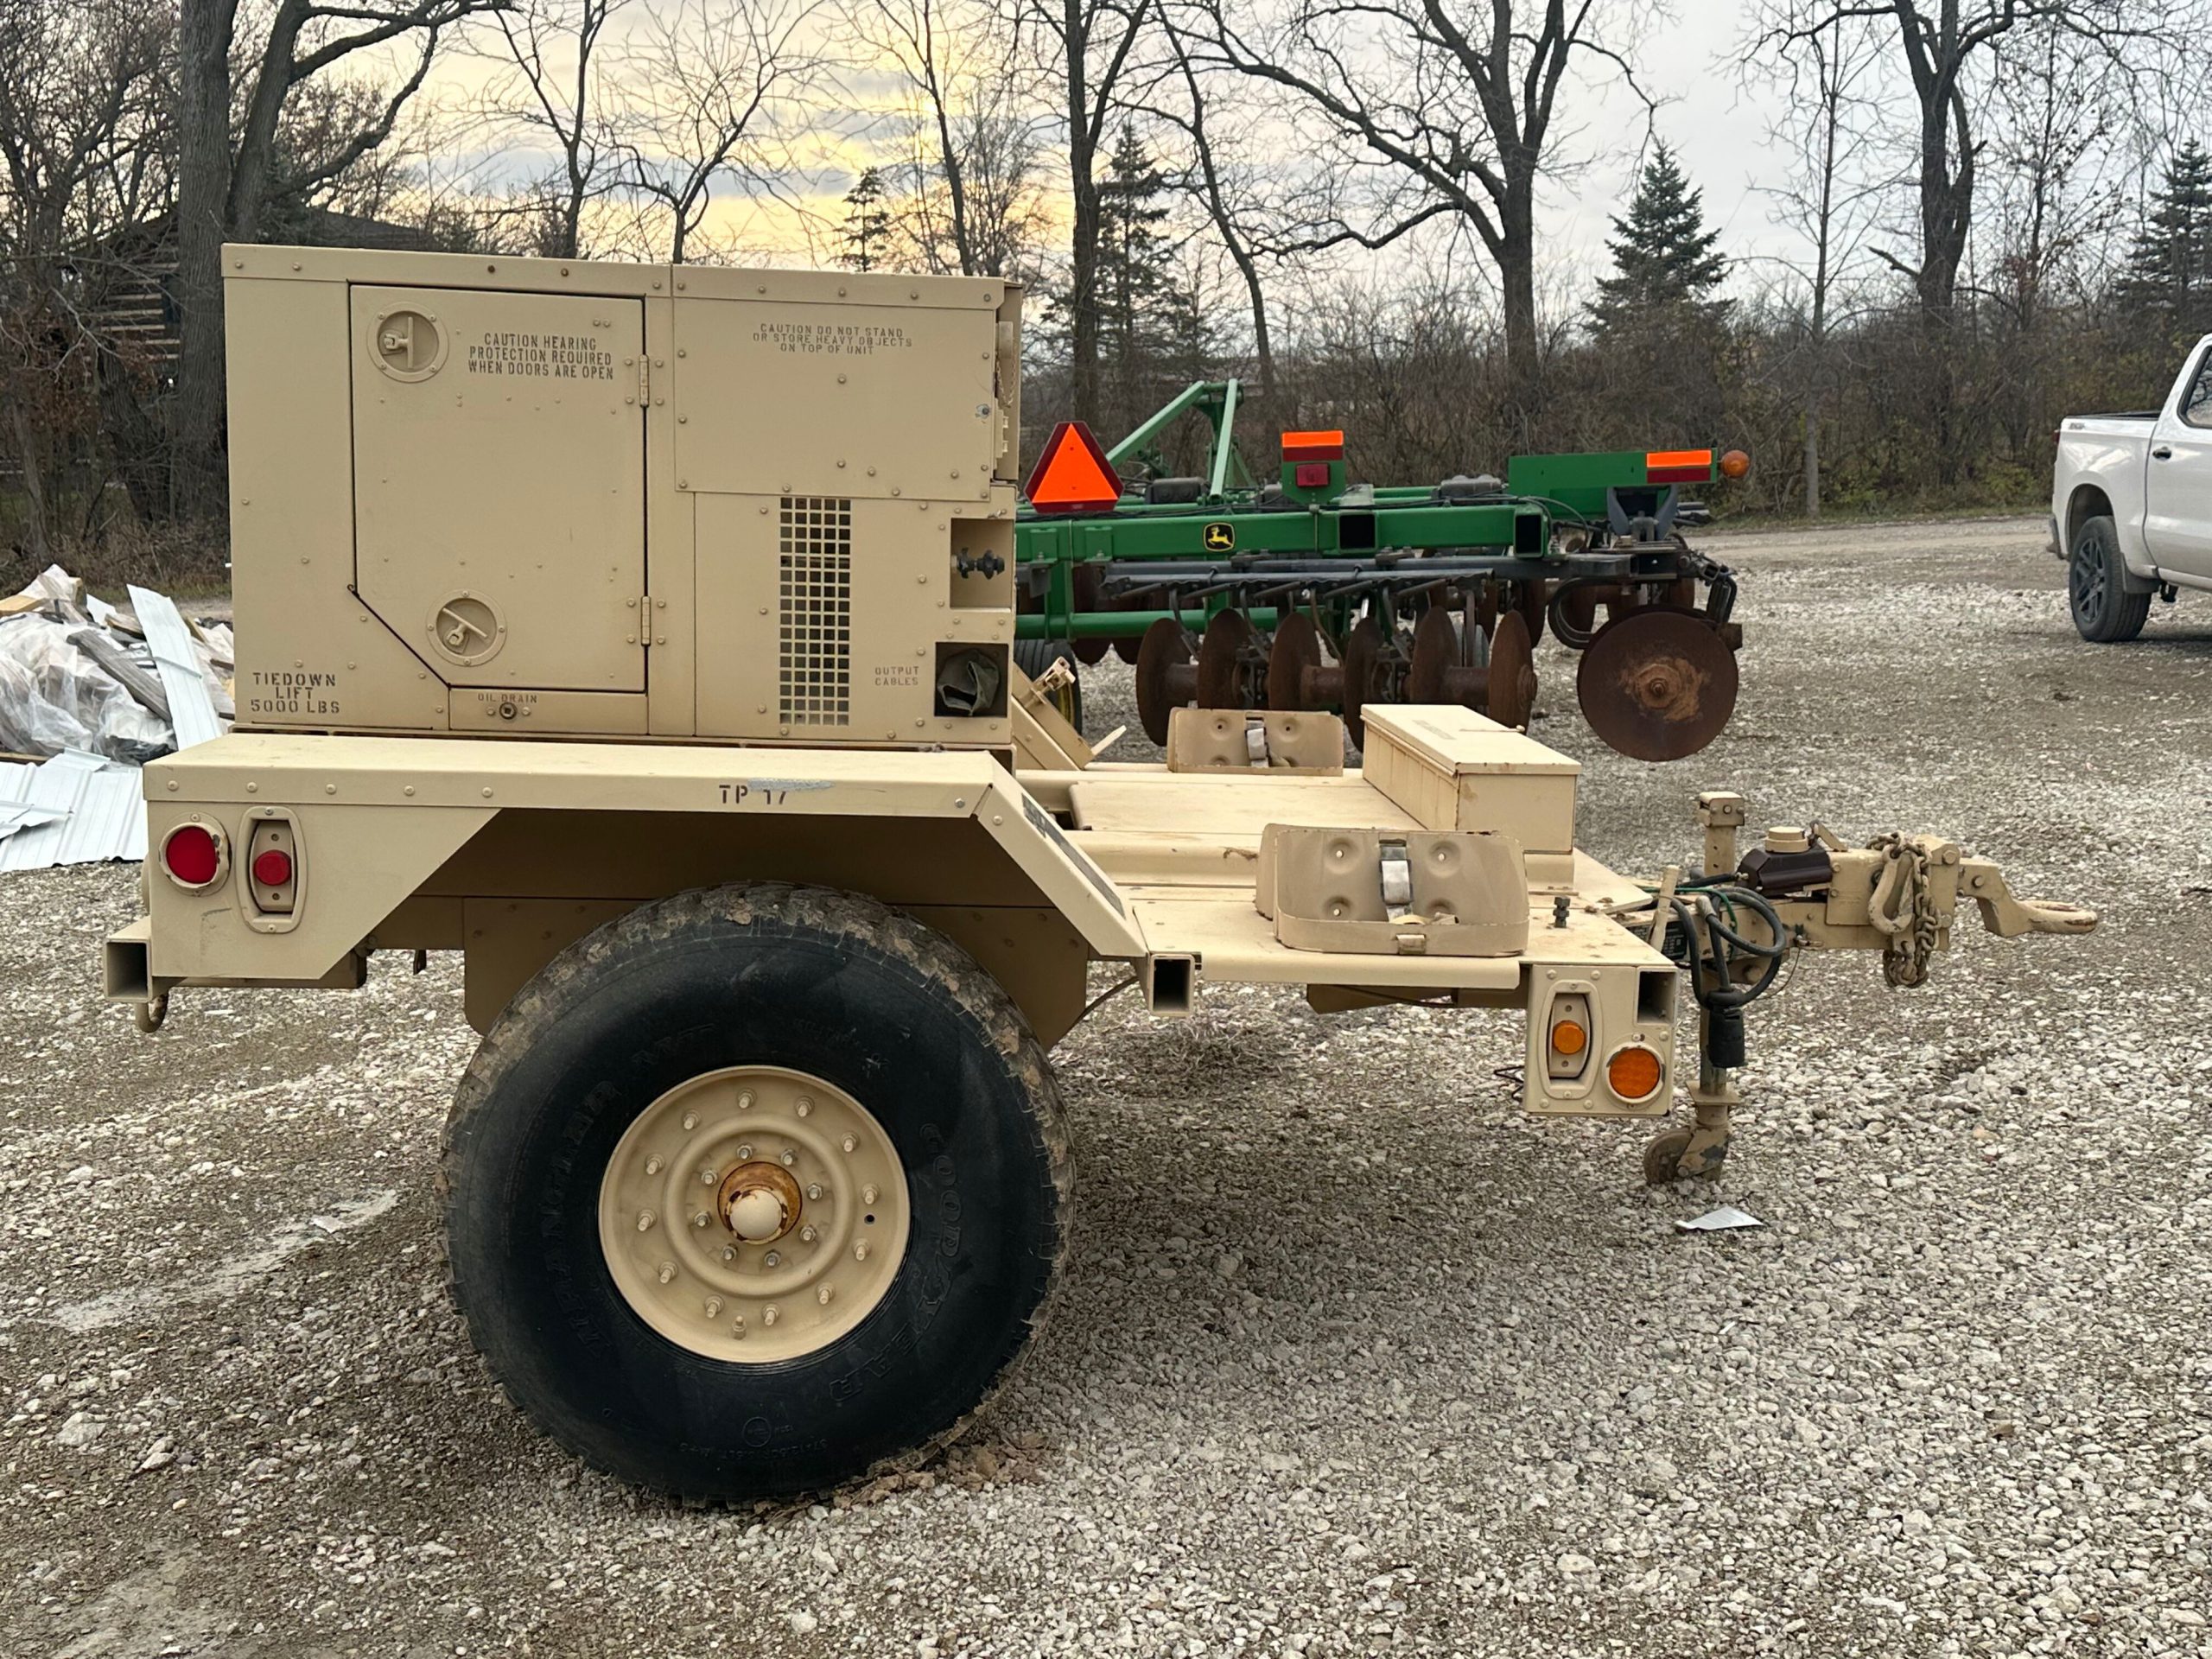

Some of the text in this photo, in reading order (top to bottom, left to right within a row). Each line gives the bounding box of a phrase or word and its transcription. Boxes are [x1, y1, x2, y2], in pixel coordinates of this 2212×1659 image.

[760, 323, 904, 338] CAUTION DO NOT STAND
[485, 332, 597, 352] CAUTION HEARING
[753, 333, 912, 347] OR STORE HEAVY OBJECTS
[470, 346, 612, 366] PROTECTION REQUIRED
[780, 342, 874, 355] ON TOP OF UNIT
[468, 359, 613, 381] WHEN DOORS ARE OPEN
[874, 666, 919, 676] OUTPUT
[251, 671, 336, 688] TIEDOWN
[874, 677, 918, 686] CABLES
[275, 686, 314, 700] LIFT
[477, 693, 537, 704] OIL DRAIN
[251, 699, 340, 715] 5000 LBS
[719, 785, 748, 804] TP
[829, 1124, 962, 1402] GOODYEAR
